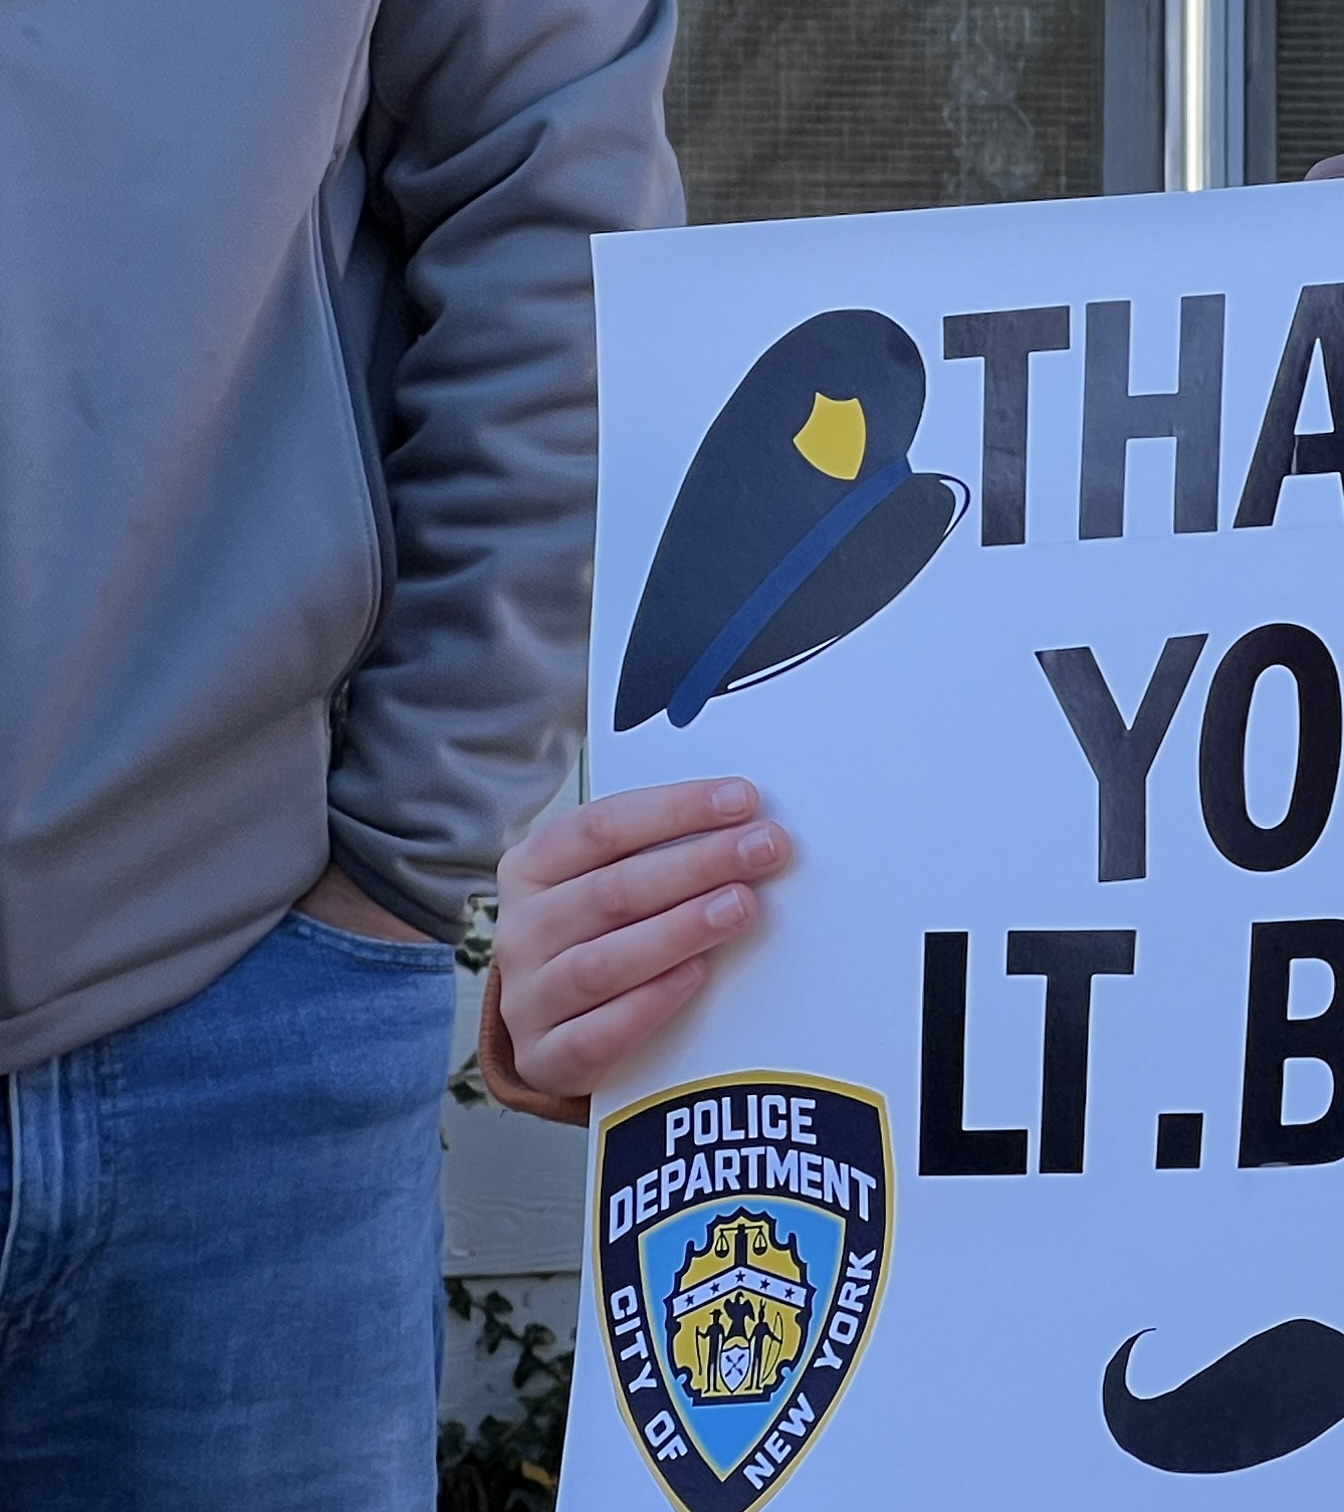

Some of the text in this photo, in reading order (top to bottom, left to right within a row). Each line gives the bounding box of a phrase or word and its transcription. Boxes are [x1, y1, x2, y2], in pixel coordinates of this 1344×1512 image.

[665, 1094, 817, 1158] POLICE
[608, 1145, 877, 1245] DEPARTMENT
[610, 1248, 877, 1491] CITY OF NEW YORK
